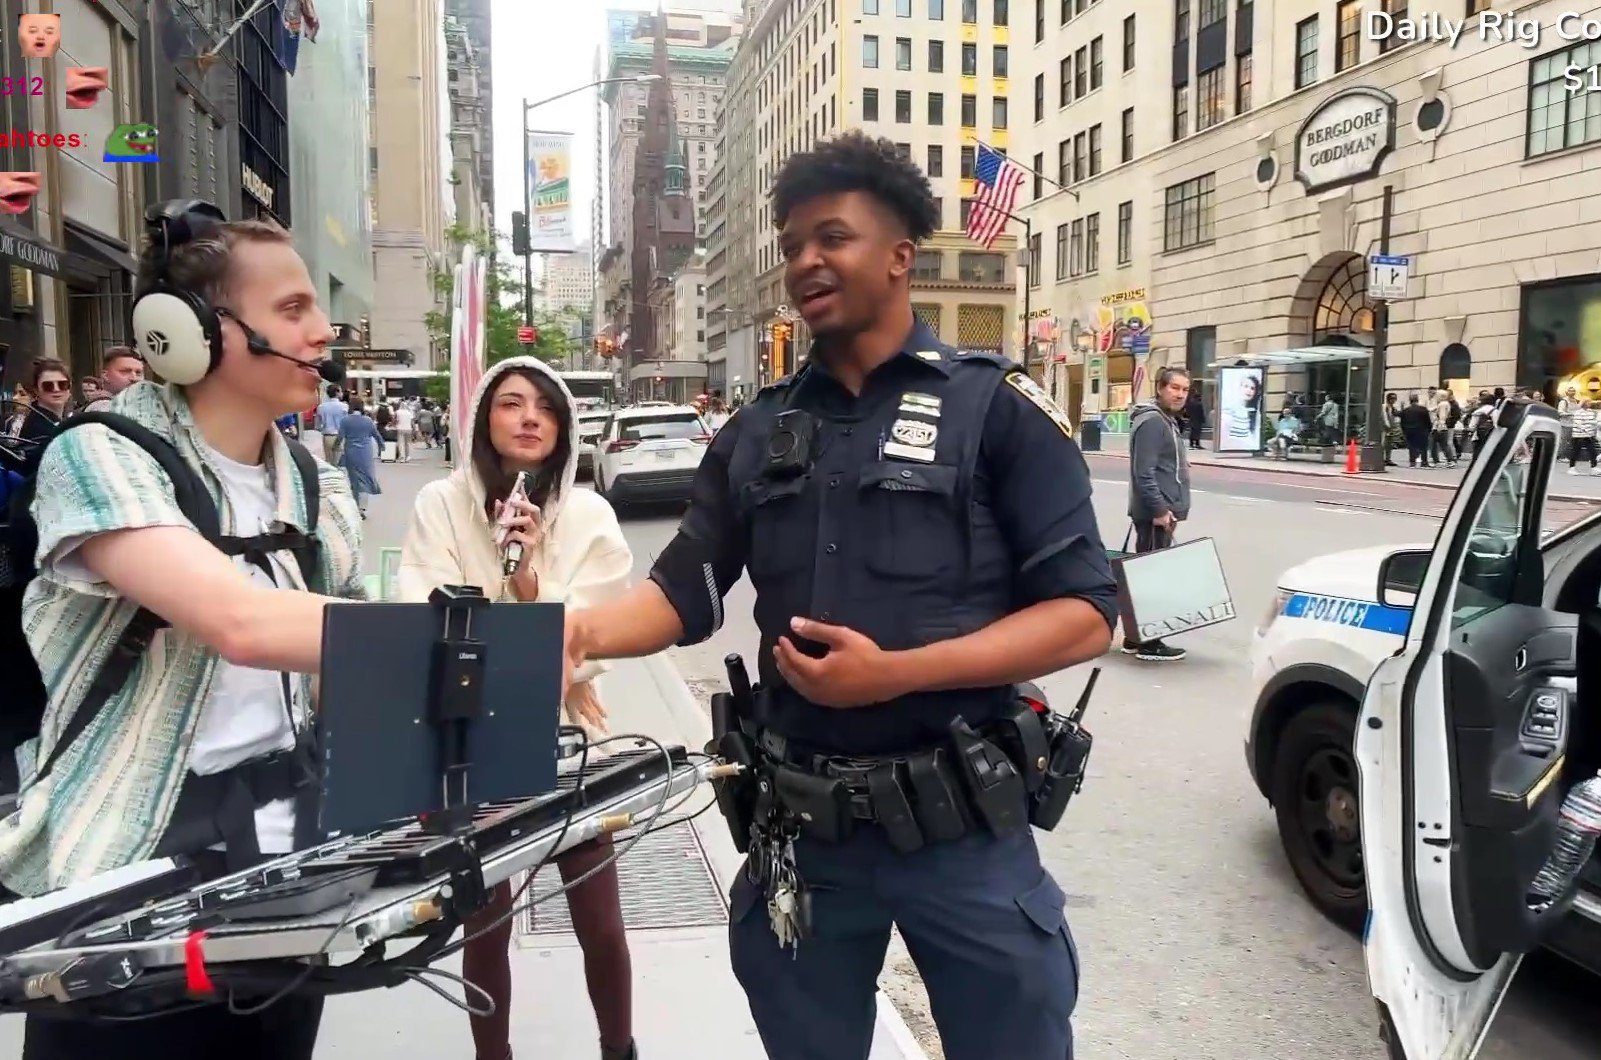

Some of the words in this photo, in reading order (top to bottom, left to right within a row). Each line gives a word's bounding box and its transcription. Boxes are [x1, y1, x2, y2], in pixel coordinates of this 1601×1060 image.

[1306, 107, 1383, 147] BERGDORF
[1310, 133, 1377, 168] GOODMAN
[1303, 596, 1367, 627] POLICE
